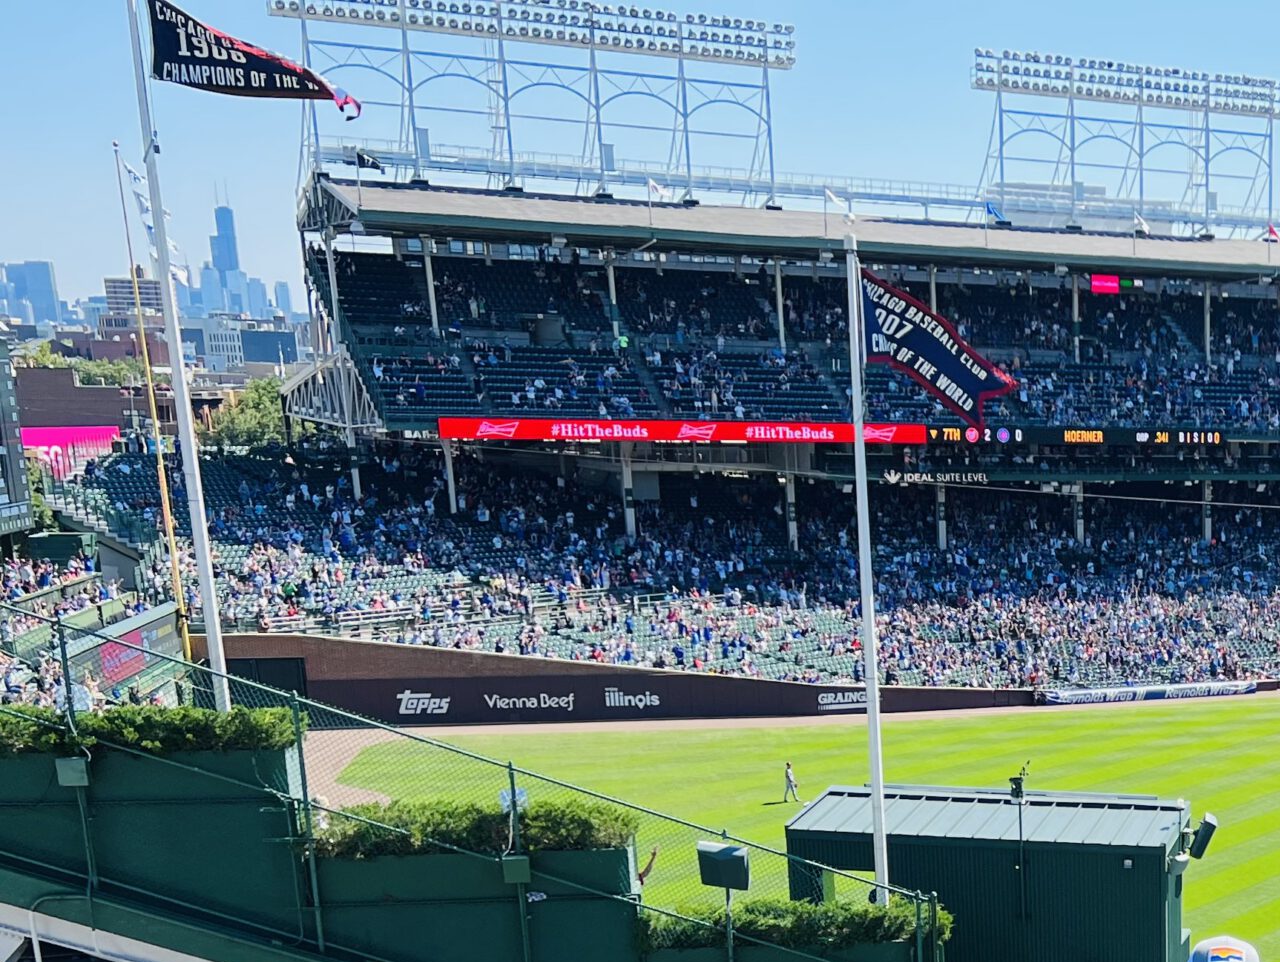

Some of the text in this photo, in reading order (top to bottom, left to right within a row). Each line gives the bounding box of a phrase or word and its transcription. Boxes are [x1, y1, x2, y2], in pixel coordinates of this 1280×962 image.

[163, 62, 245, 87] CHAMPIONS
[250, 71, 267, 88] OF
[273, 73, 300, 89] THE
[905, 306, 959, 356] BASEBALL
[960, 353, 988, 381] CLUB
[896, 347, 974, 411] OF THE WORLD
[551, 423, 834, 440] #HitTheBuds #HitTheBuds
[943, 428, 961, 441] 7TH
[984, 429, 991, 441] 2
[1064, 430, 1103, 443] HOERNER
[903, 473, 989, 483] IDEAL SUITE LEVEL
[818, 691, 883, 705] GRAING
[1105, 691, 1133, 703] Wrap
[1165, 686, 1209, 699] Reynolds
[483, 692, 575, 711] Vienna Beef
